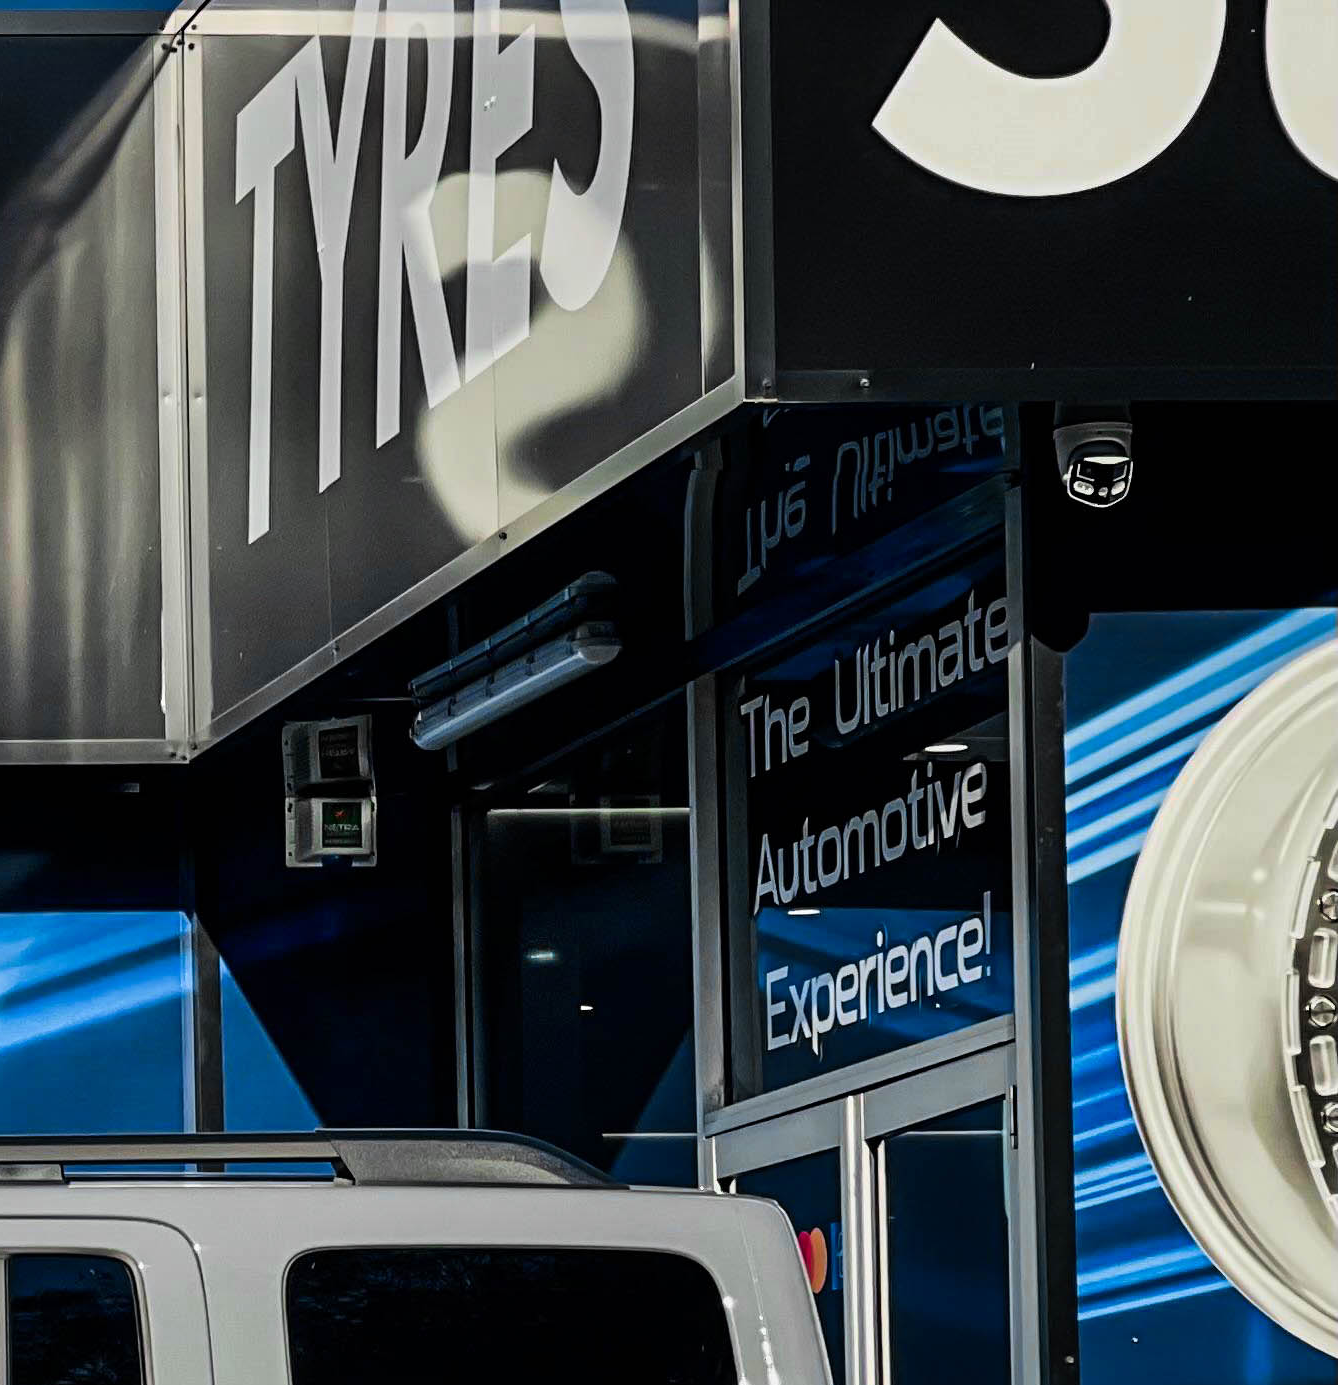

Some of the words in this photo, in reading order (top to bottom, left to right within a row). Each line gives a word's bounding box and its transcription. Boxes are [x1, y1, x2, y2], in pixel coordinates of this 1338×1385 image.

[235, 0, 635, 545] TYRES
[740, 694, 810, 778] The
[834, 589, 1011, 735] Ultimate
[754, 761, 987, 916] Automotive
[766, 890, 992, 1056] Experience!
